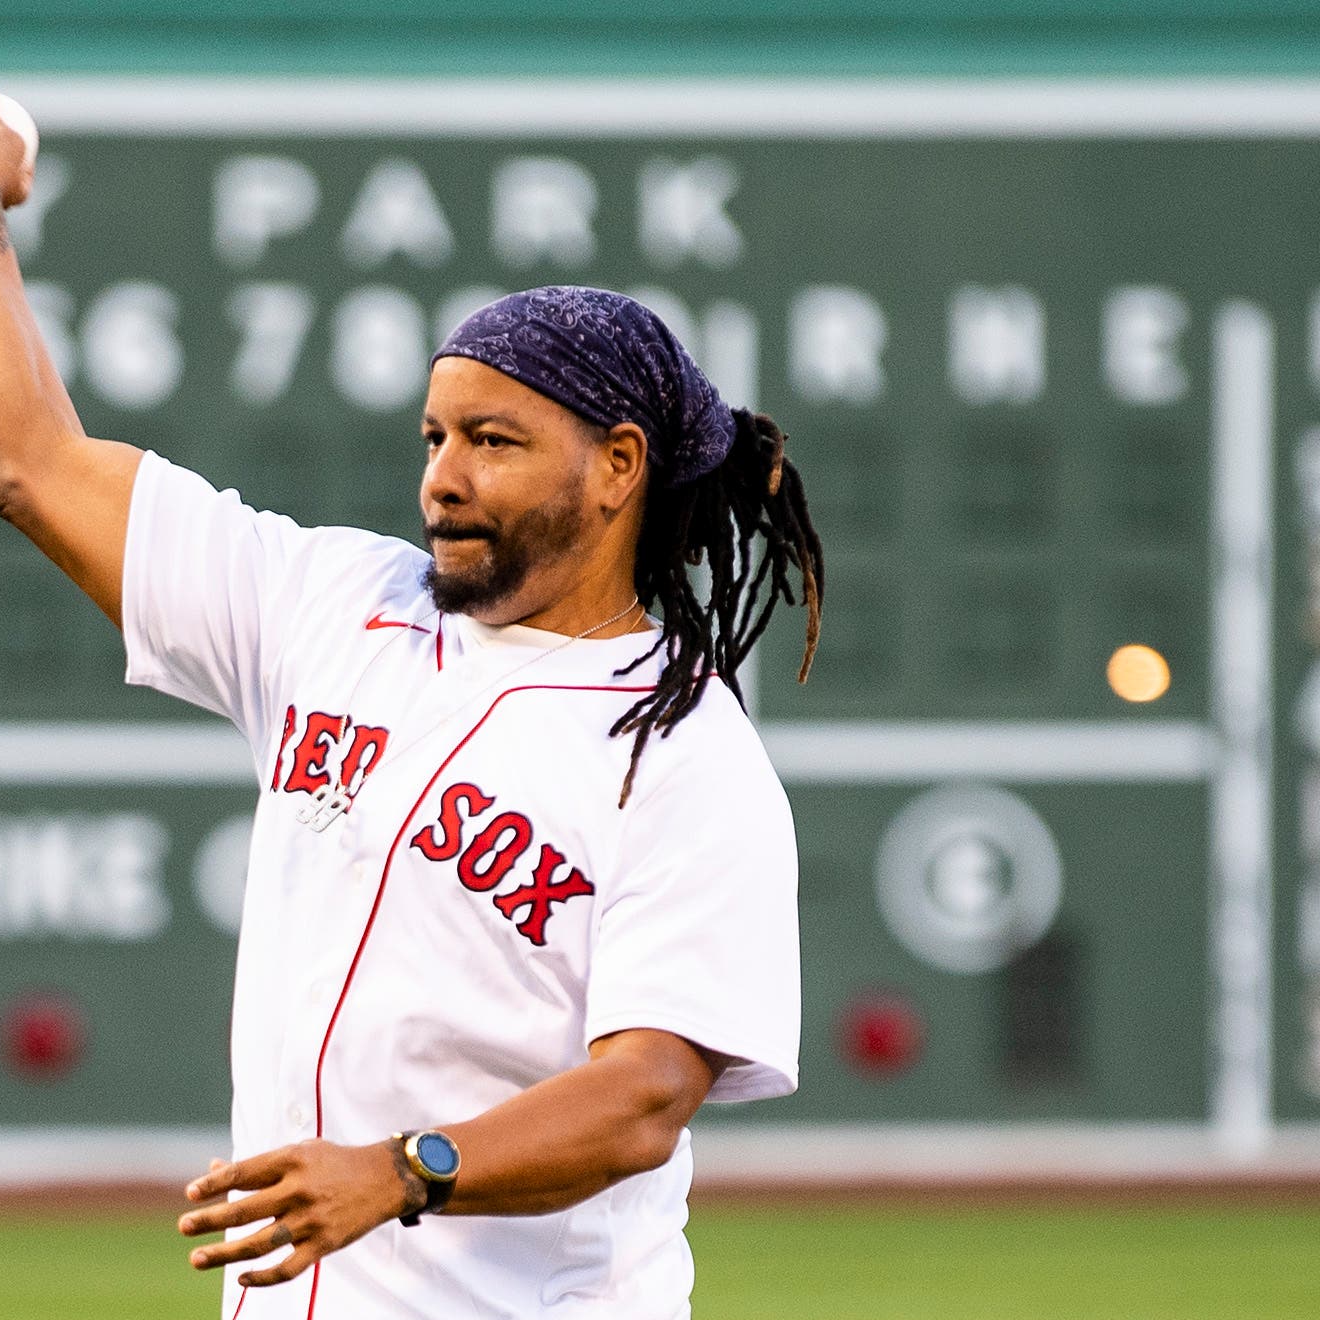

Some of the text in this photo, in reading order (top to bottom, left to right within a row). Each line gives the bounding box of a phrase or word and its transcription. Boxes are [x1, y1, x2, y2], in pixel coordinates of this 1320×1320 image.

[213, 156, 742, 266] PARK
[83, 282, 180, 404] 6
[234, 283, 311, 400] 7
[791, 288, 885, 398] R
[1104, 288, 1184, 403] E
[410, 782, 595, 947] SOX
